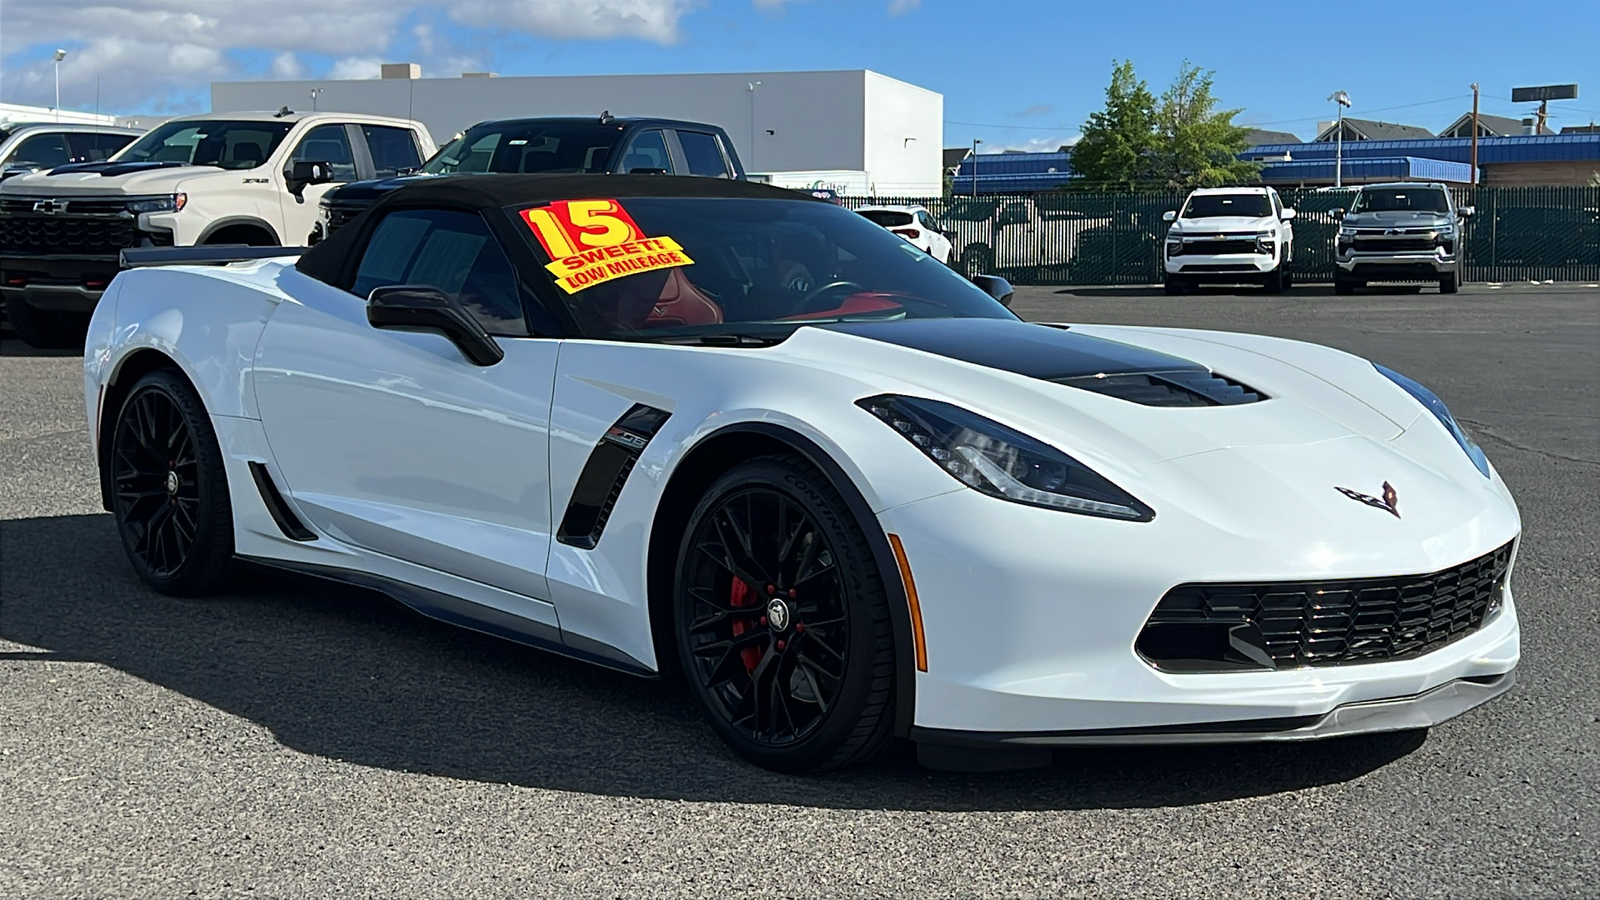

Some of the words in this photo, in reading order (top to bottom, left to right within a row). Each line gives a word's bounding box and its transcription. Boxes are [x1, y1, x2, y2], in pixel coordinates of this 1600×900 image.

[529, 201, 636, 258] 15
[562, 239, 664, 270] SWEET!
[565, 266, 609, 289] LOW
[606, 252, 683, 275] MILEAGE
